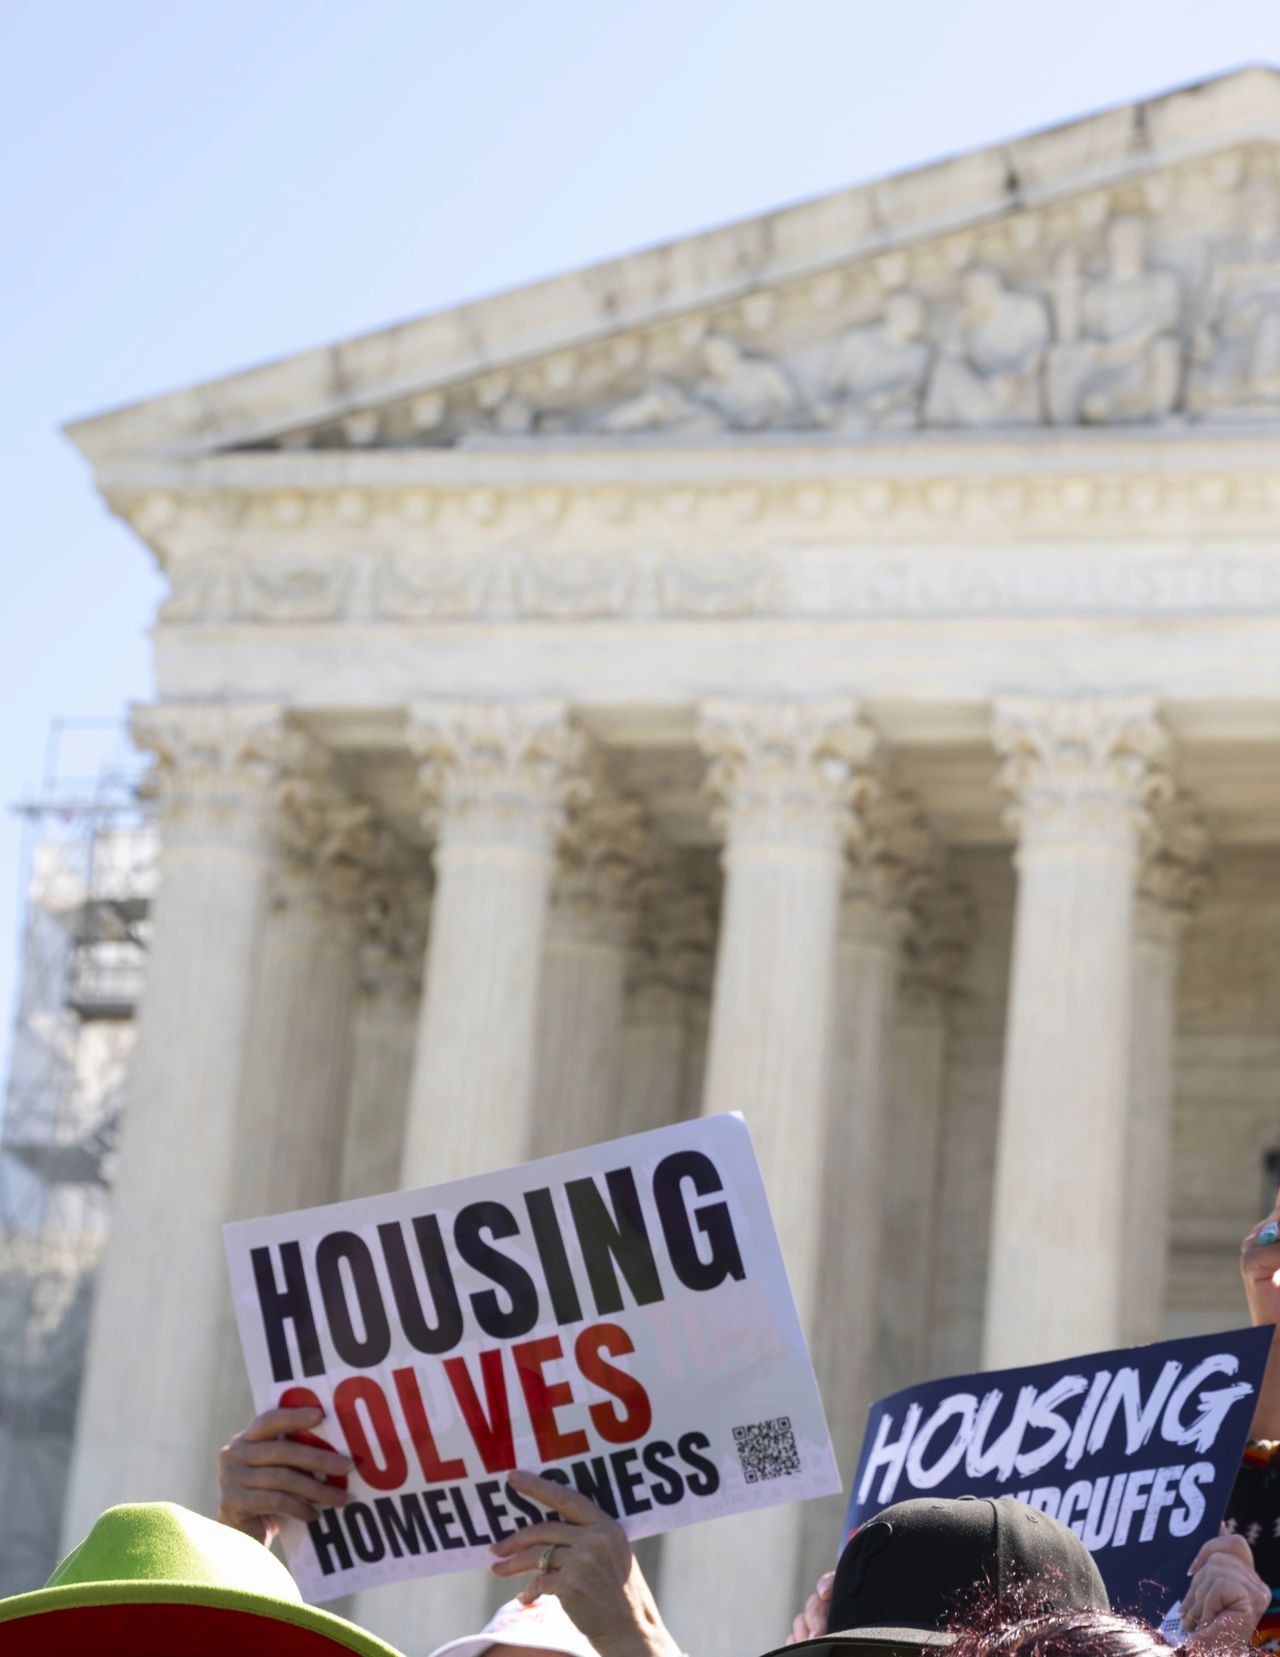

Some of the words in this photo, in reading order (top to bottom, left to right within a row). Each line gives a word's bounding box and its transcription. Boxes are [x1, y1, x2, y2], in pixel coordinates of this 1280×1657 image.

[250, 1150, 746, 1382] HOUSING
[307, 1431, 720, 1575] HOMELESNESS
[857, 1353, 1255, 1505] HOUSING
